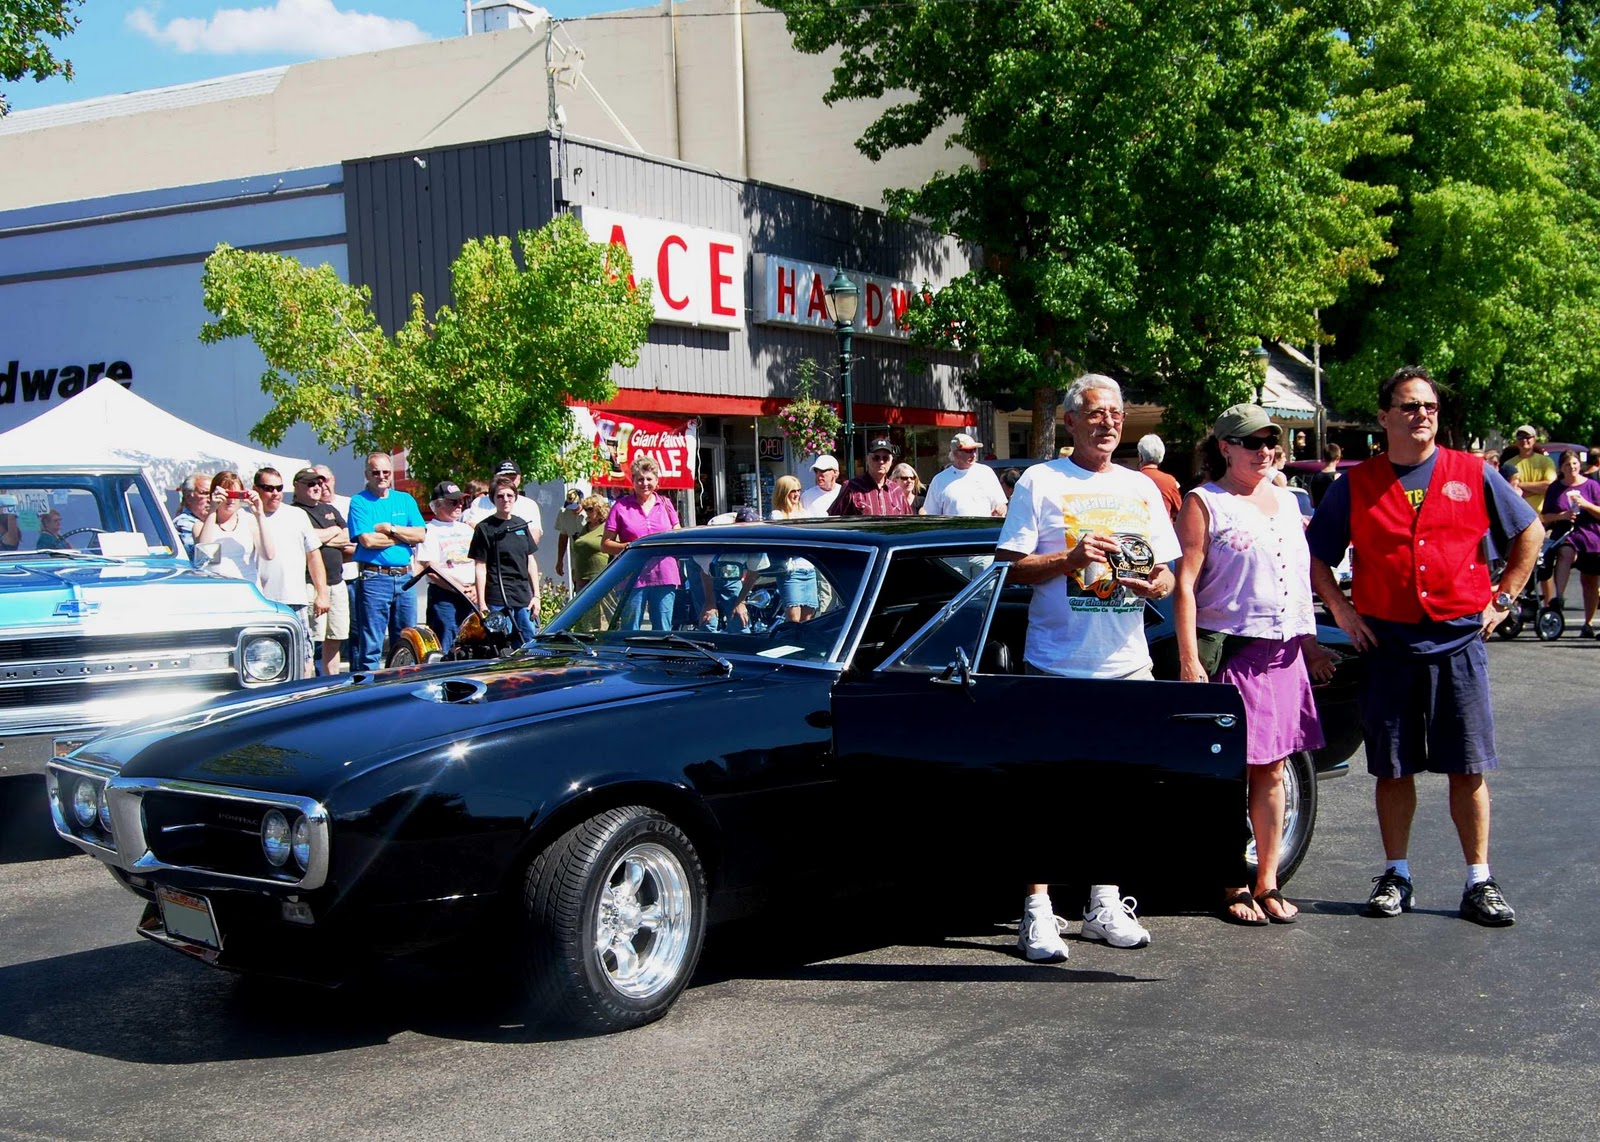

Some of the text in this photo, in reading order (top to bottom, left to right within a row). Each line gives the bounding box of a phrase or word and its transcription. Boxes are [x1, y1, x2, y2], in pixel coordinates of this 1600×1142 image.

[777, 266, 960, 340] HADW
[632, 430, 659, 447] Giant
[759, 438, 783, 456] OPEN
[218, 812, 259, 826] PONTIAC
